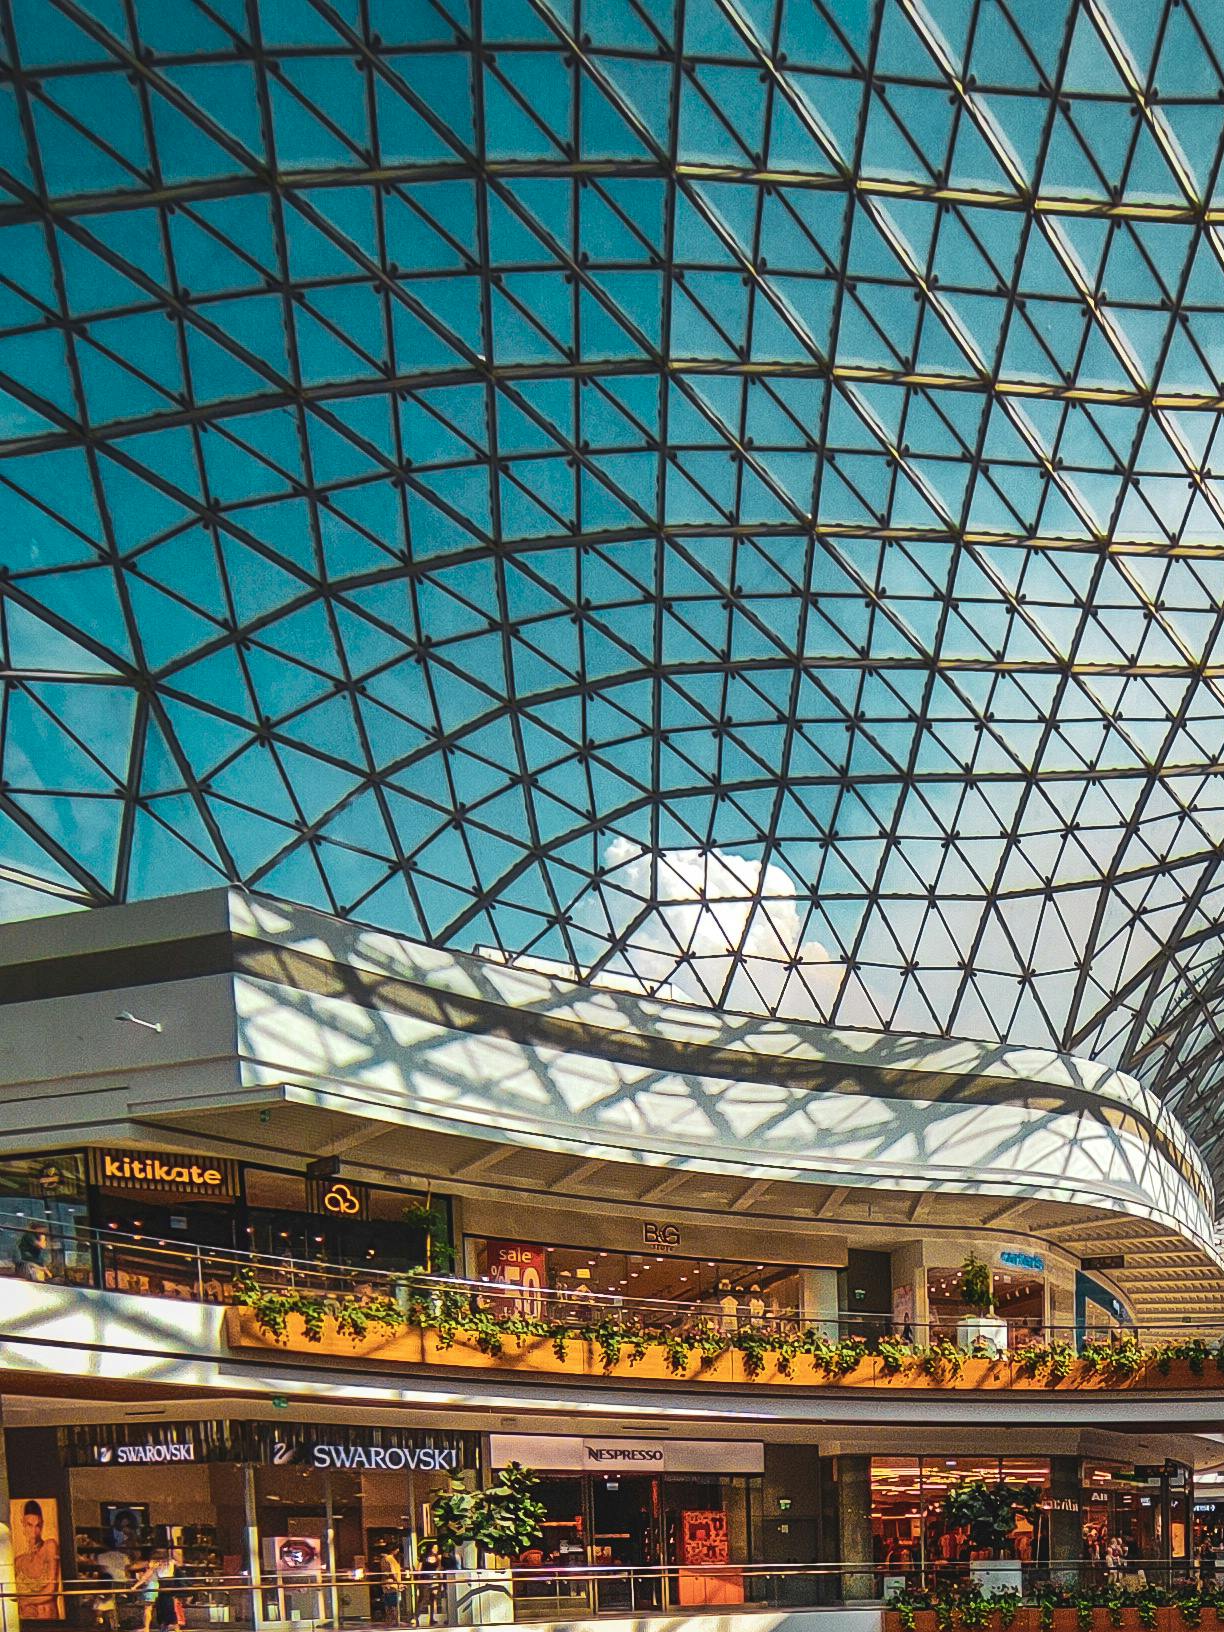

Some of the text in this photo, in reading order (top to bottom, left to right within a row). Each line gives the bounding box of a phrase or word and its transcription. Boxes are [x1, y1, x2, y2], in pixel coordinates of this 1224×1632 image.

[104, 1156, 222, 1185] kitikate
[499, 1247, 533, 1264] sale
[117, 1443, 195, 1463] SWAROVSKI
[313, 1445, 457, 1470] SWAROVSKI
[584, 1445, 664, 1462] NESPRESSO
